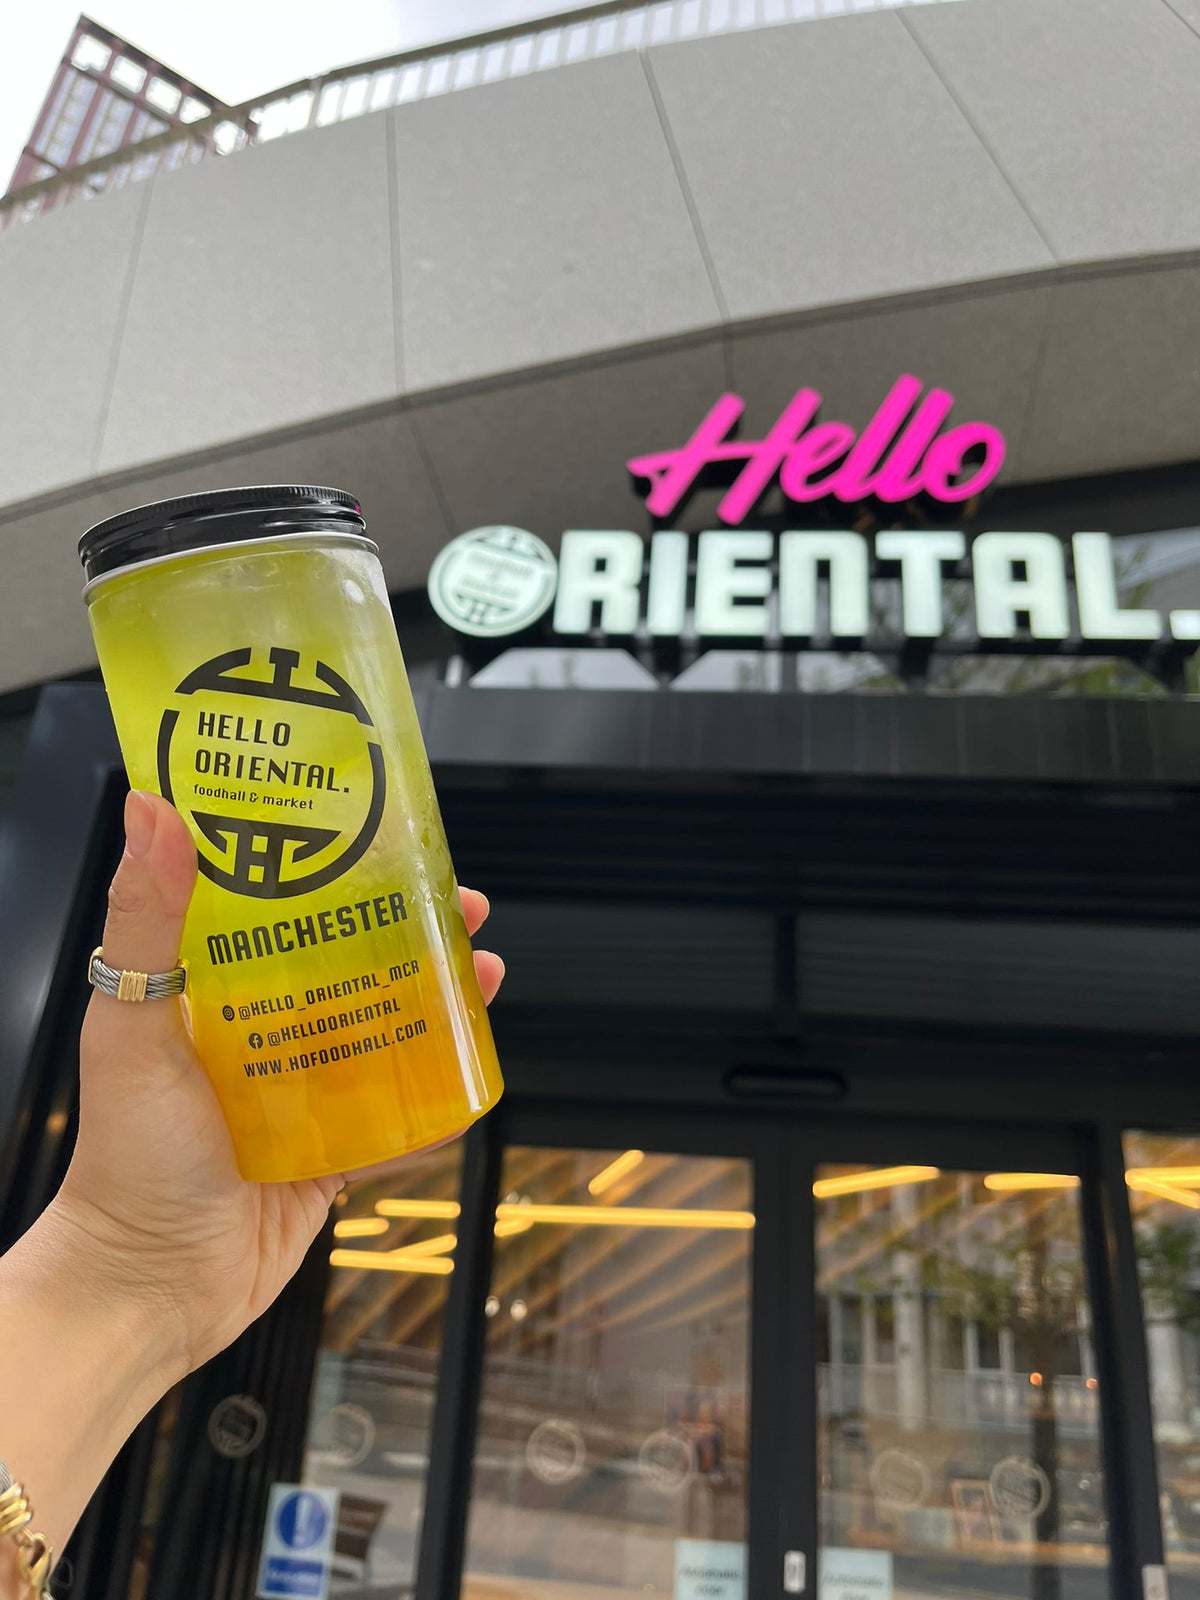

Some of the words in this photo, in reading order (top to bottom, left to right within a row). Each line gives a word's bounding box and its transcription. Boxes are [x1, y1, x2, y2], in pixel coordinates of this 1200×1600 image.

[627, 373, 1007, 525] Hello
[197, 711, 291, 747] HELLO
[195, 749, 350, 793] ORIENTAL.
[193, 784, 246, 802] foodhall
[248, 791, 259, 804] &
[262, 794, 314, 810] market
[207, 892, 408, 965] MANCHESTER
[267, 998, 401, 1047] @HELLOORIENTAL
[243, 1019, 427, 1078] WWW.HOFOODHALL.COM
